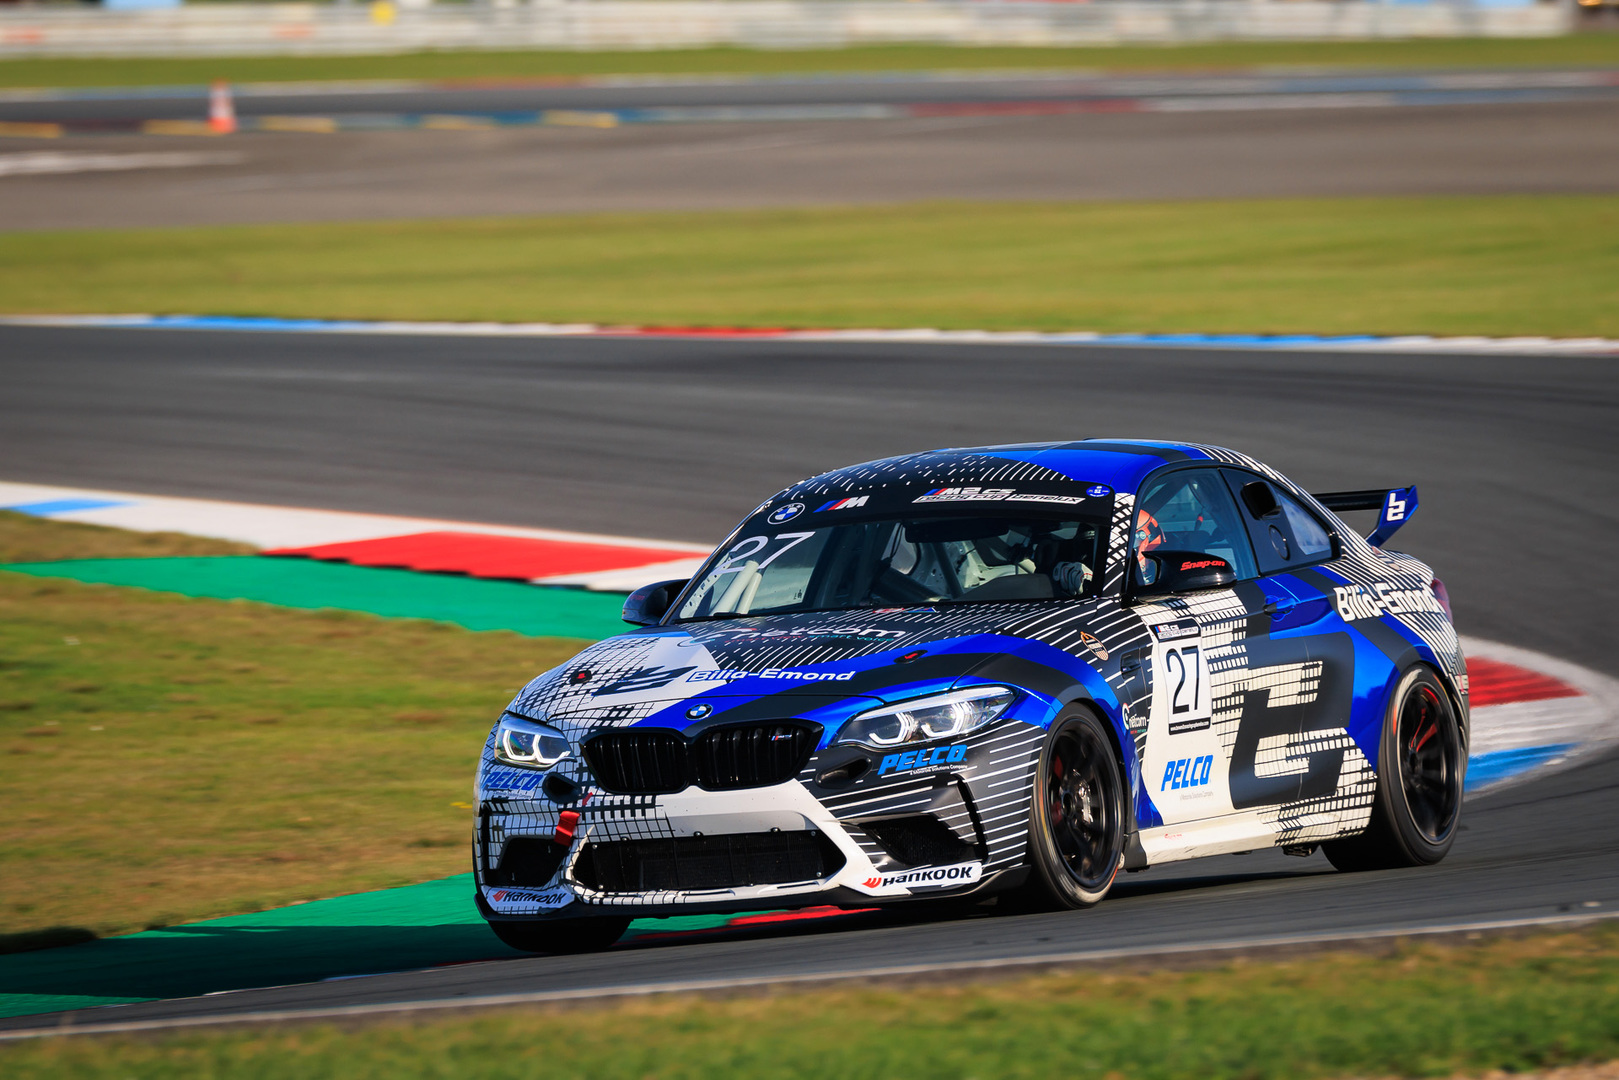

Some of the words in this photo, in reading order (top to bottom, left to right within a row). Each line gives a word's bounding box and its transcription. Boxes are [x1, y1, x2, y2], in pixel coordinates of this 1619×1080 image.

[708, 531, 816, 577] 27
[1180, 560, 1226, 571] Snap-on
[1333, 582, 1446, 622] Bilia-Emond
[731, 626, 906, 640] netcom
[686, 667, 856, 683] Bilia-Emond
[1166, 645, 1200, 715] 27
[877, 744, 967, 775] PELCO
[1161, 754, 1213, 792] PELCO
[481, 771, 544, 791] PELCO
